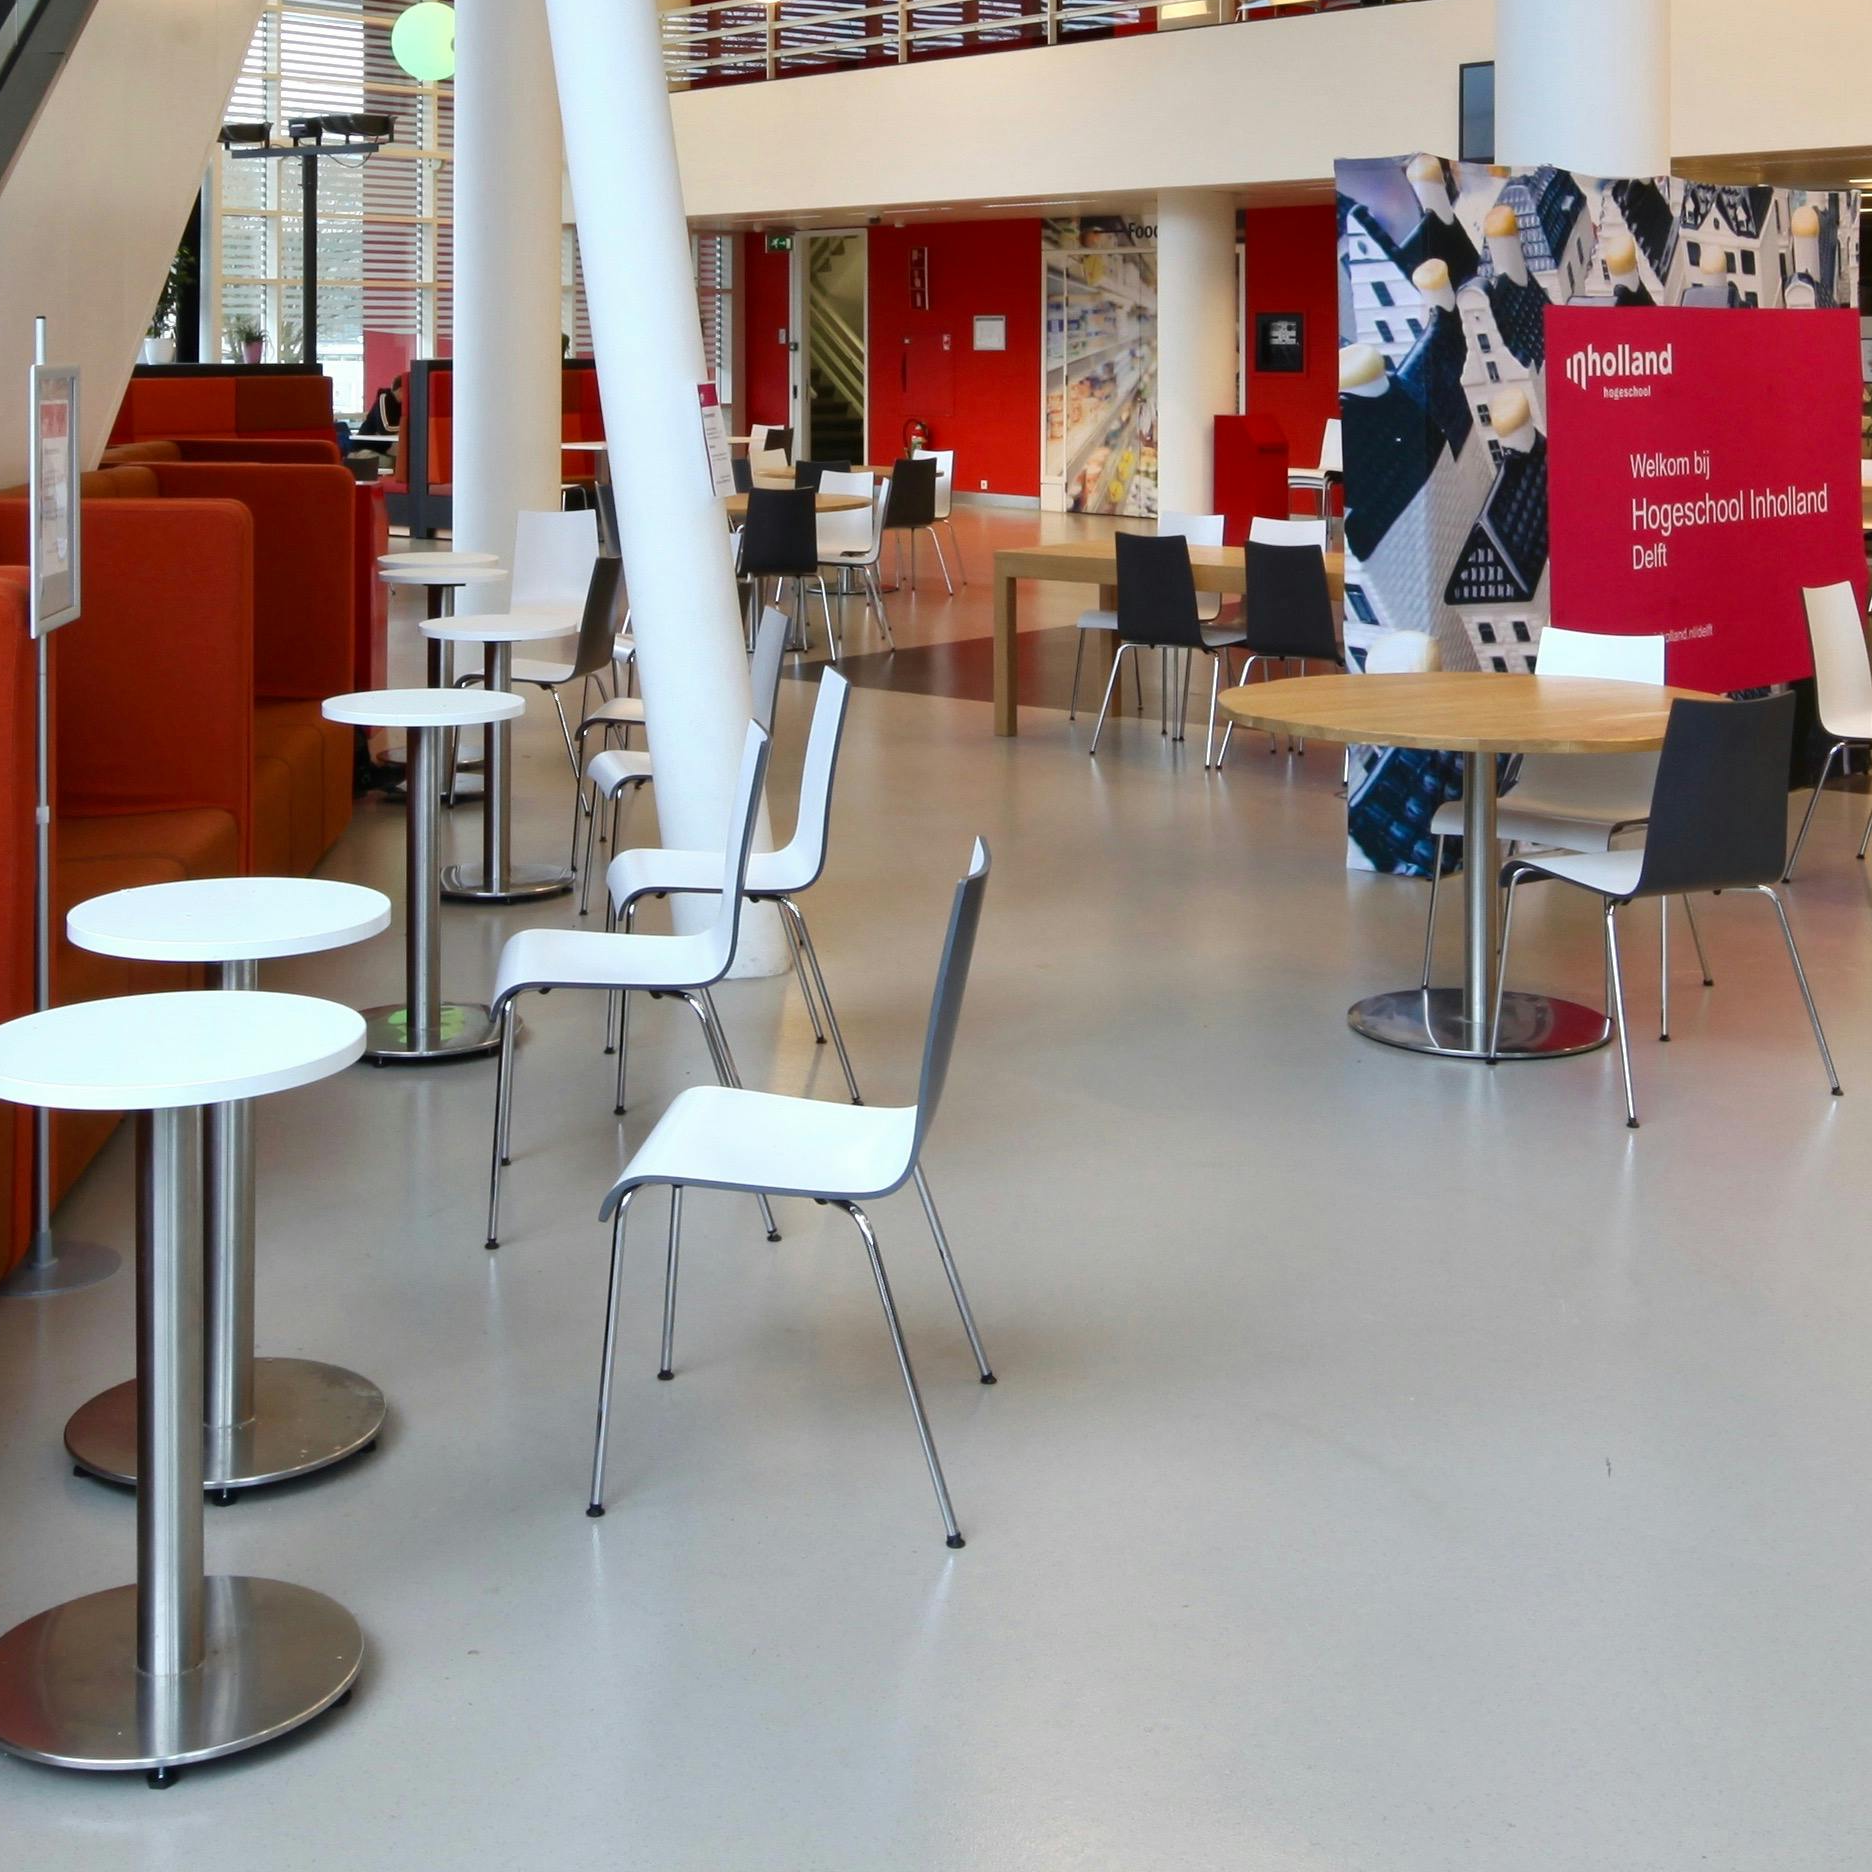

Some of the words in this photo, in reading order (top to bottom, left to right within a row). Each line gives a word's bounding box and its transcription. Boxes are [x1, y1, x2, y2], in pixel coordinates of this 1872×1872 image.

[1565, 342, 1673, 391] inholland
[1602, 385, 1652, 401] hogeschool
[1630, 452, 1689, 479] Welkom
[1693, 449, 1711, 480] bij
[1632, 489, 1744, 537] Hogeschool
[1749, 482, 1828, 520] Inholland
[1632, 542, 1668, 570] Delft
